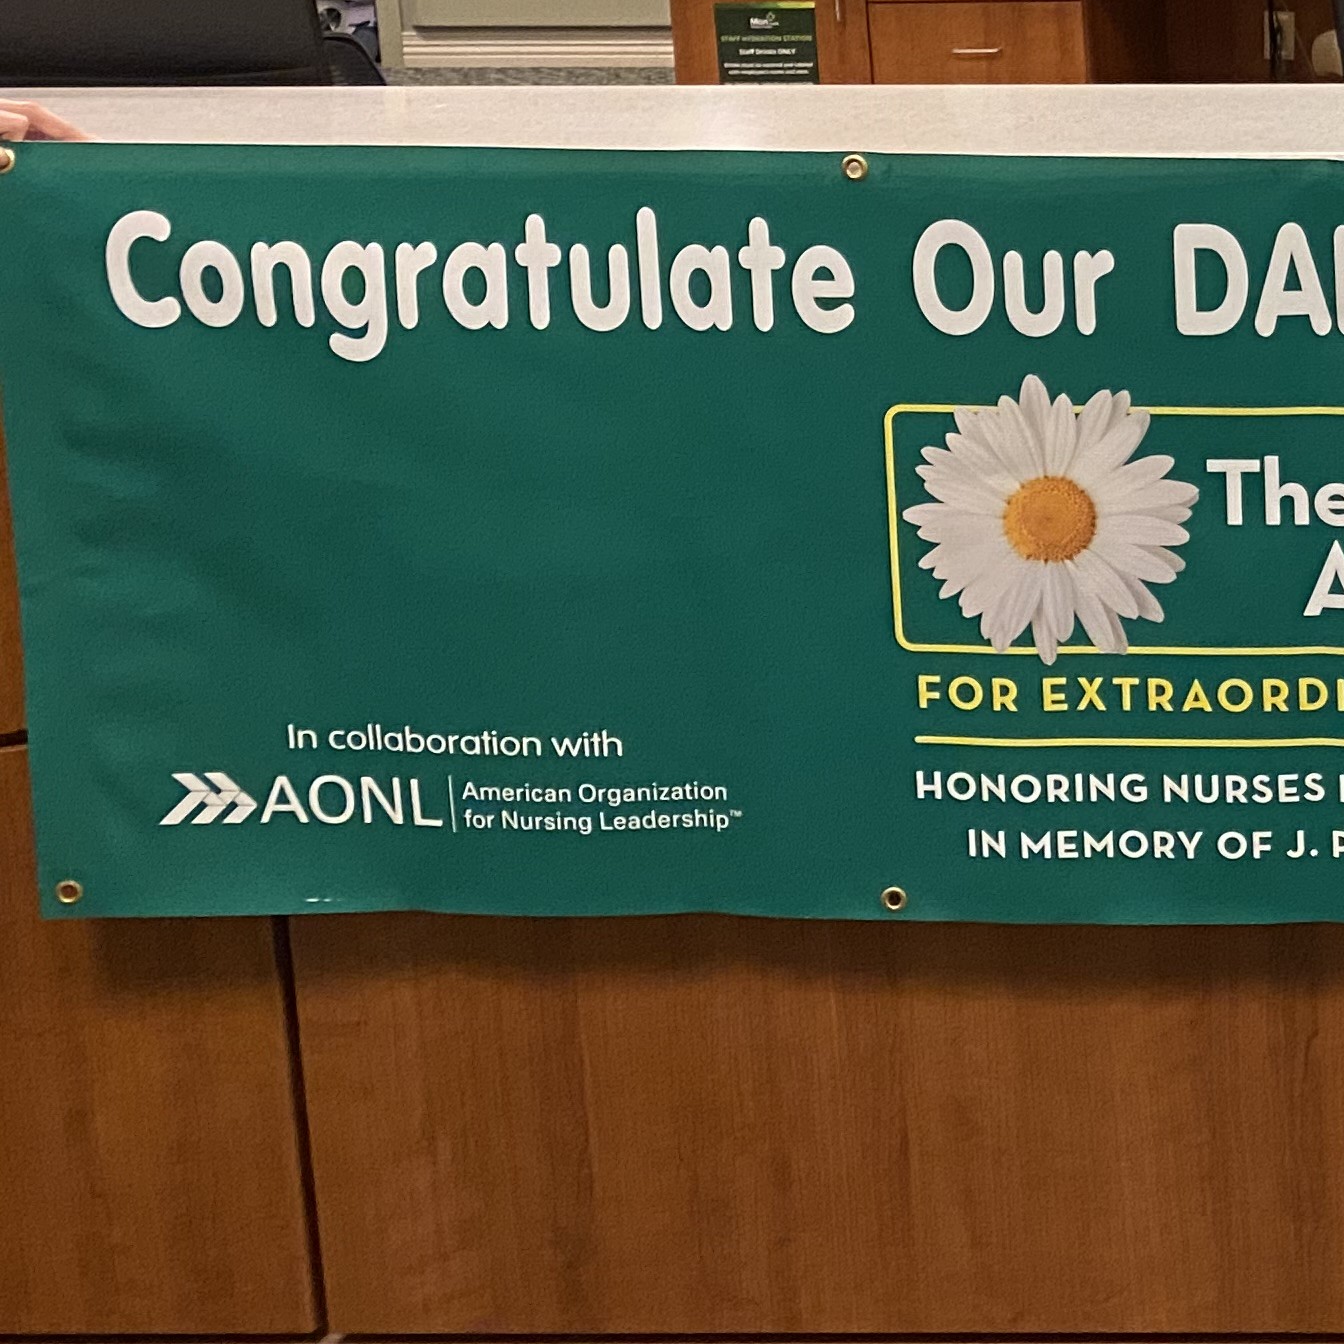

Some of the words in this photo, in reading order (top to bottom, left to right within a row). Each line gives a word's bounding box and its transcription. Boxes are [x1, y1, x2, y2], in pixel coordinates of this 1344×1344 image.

[106, 207, 855, 361] Congratulate
[913, 219, 1114, 337] Our
[919, 675, 1017, 711] FOR
[288, 724, 317, 748] In
[329, 724, 541, 756] collaboration
[551, 729, 622, 757] with
[261, 775, 443, 826] AONL
[463, 782, 571, 802] American
[579, 781, 726, 805] Organization
[916, 771, 1147, 803] HONORING
[1164, 773, 1325, 803] NURSES
[464, 809, 494, 828] for
[502, 810, 592, 834] Nursing
[969, 829, 1005, 858] IN
[1021, 830, 1203, 859] MEMORY
[1218, 831, 1272, 859] OF
[1287, 830, 1318, 858] J.
